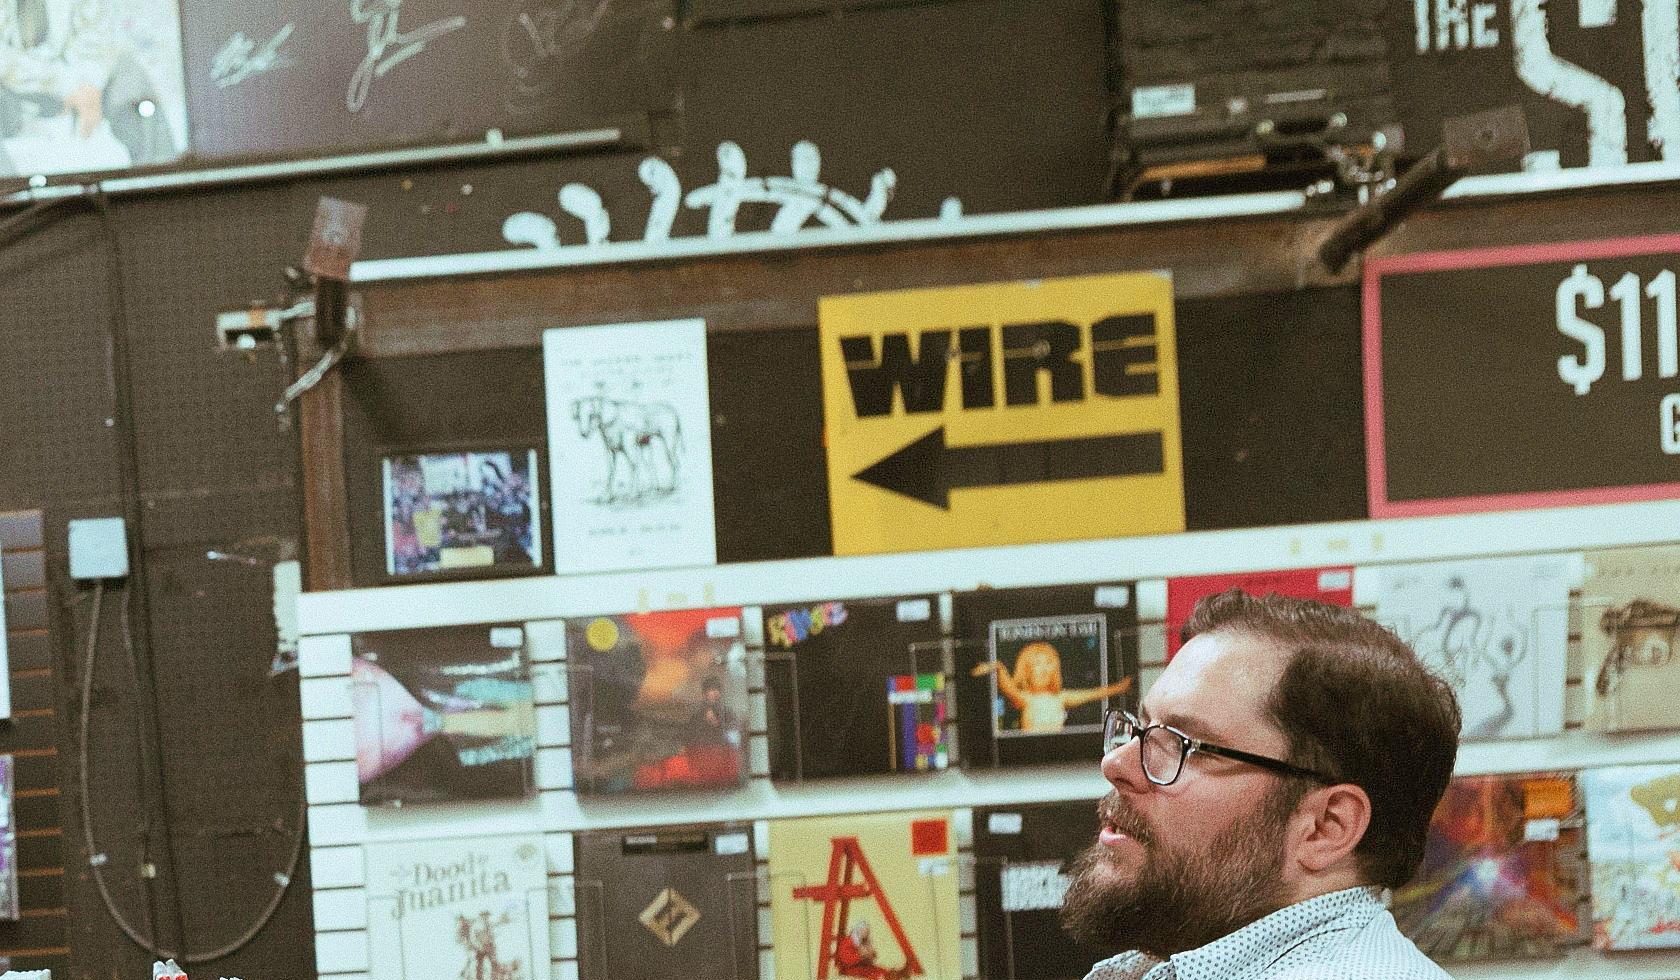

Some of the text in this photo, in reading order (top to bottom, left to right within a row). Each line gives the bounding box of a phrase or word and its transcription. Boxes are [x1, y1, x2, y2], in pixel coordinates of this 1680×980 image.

[839, 312, 1160, 420] WIRE
[413, 852, 475, 885] Dood
[391, 870, 511, 920] Juanita
